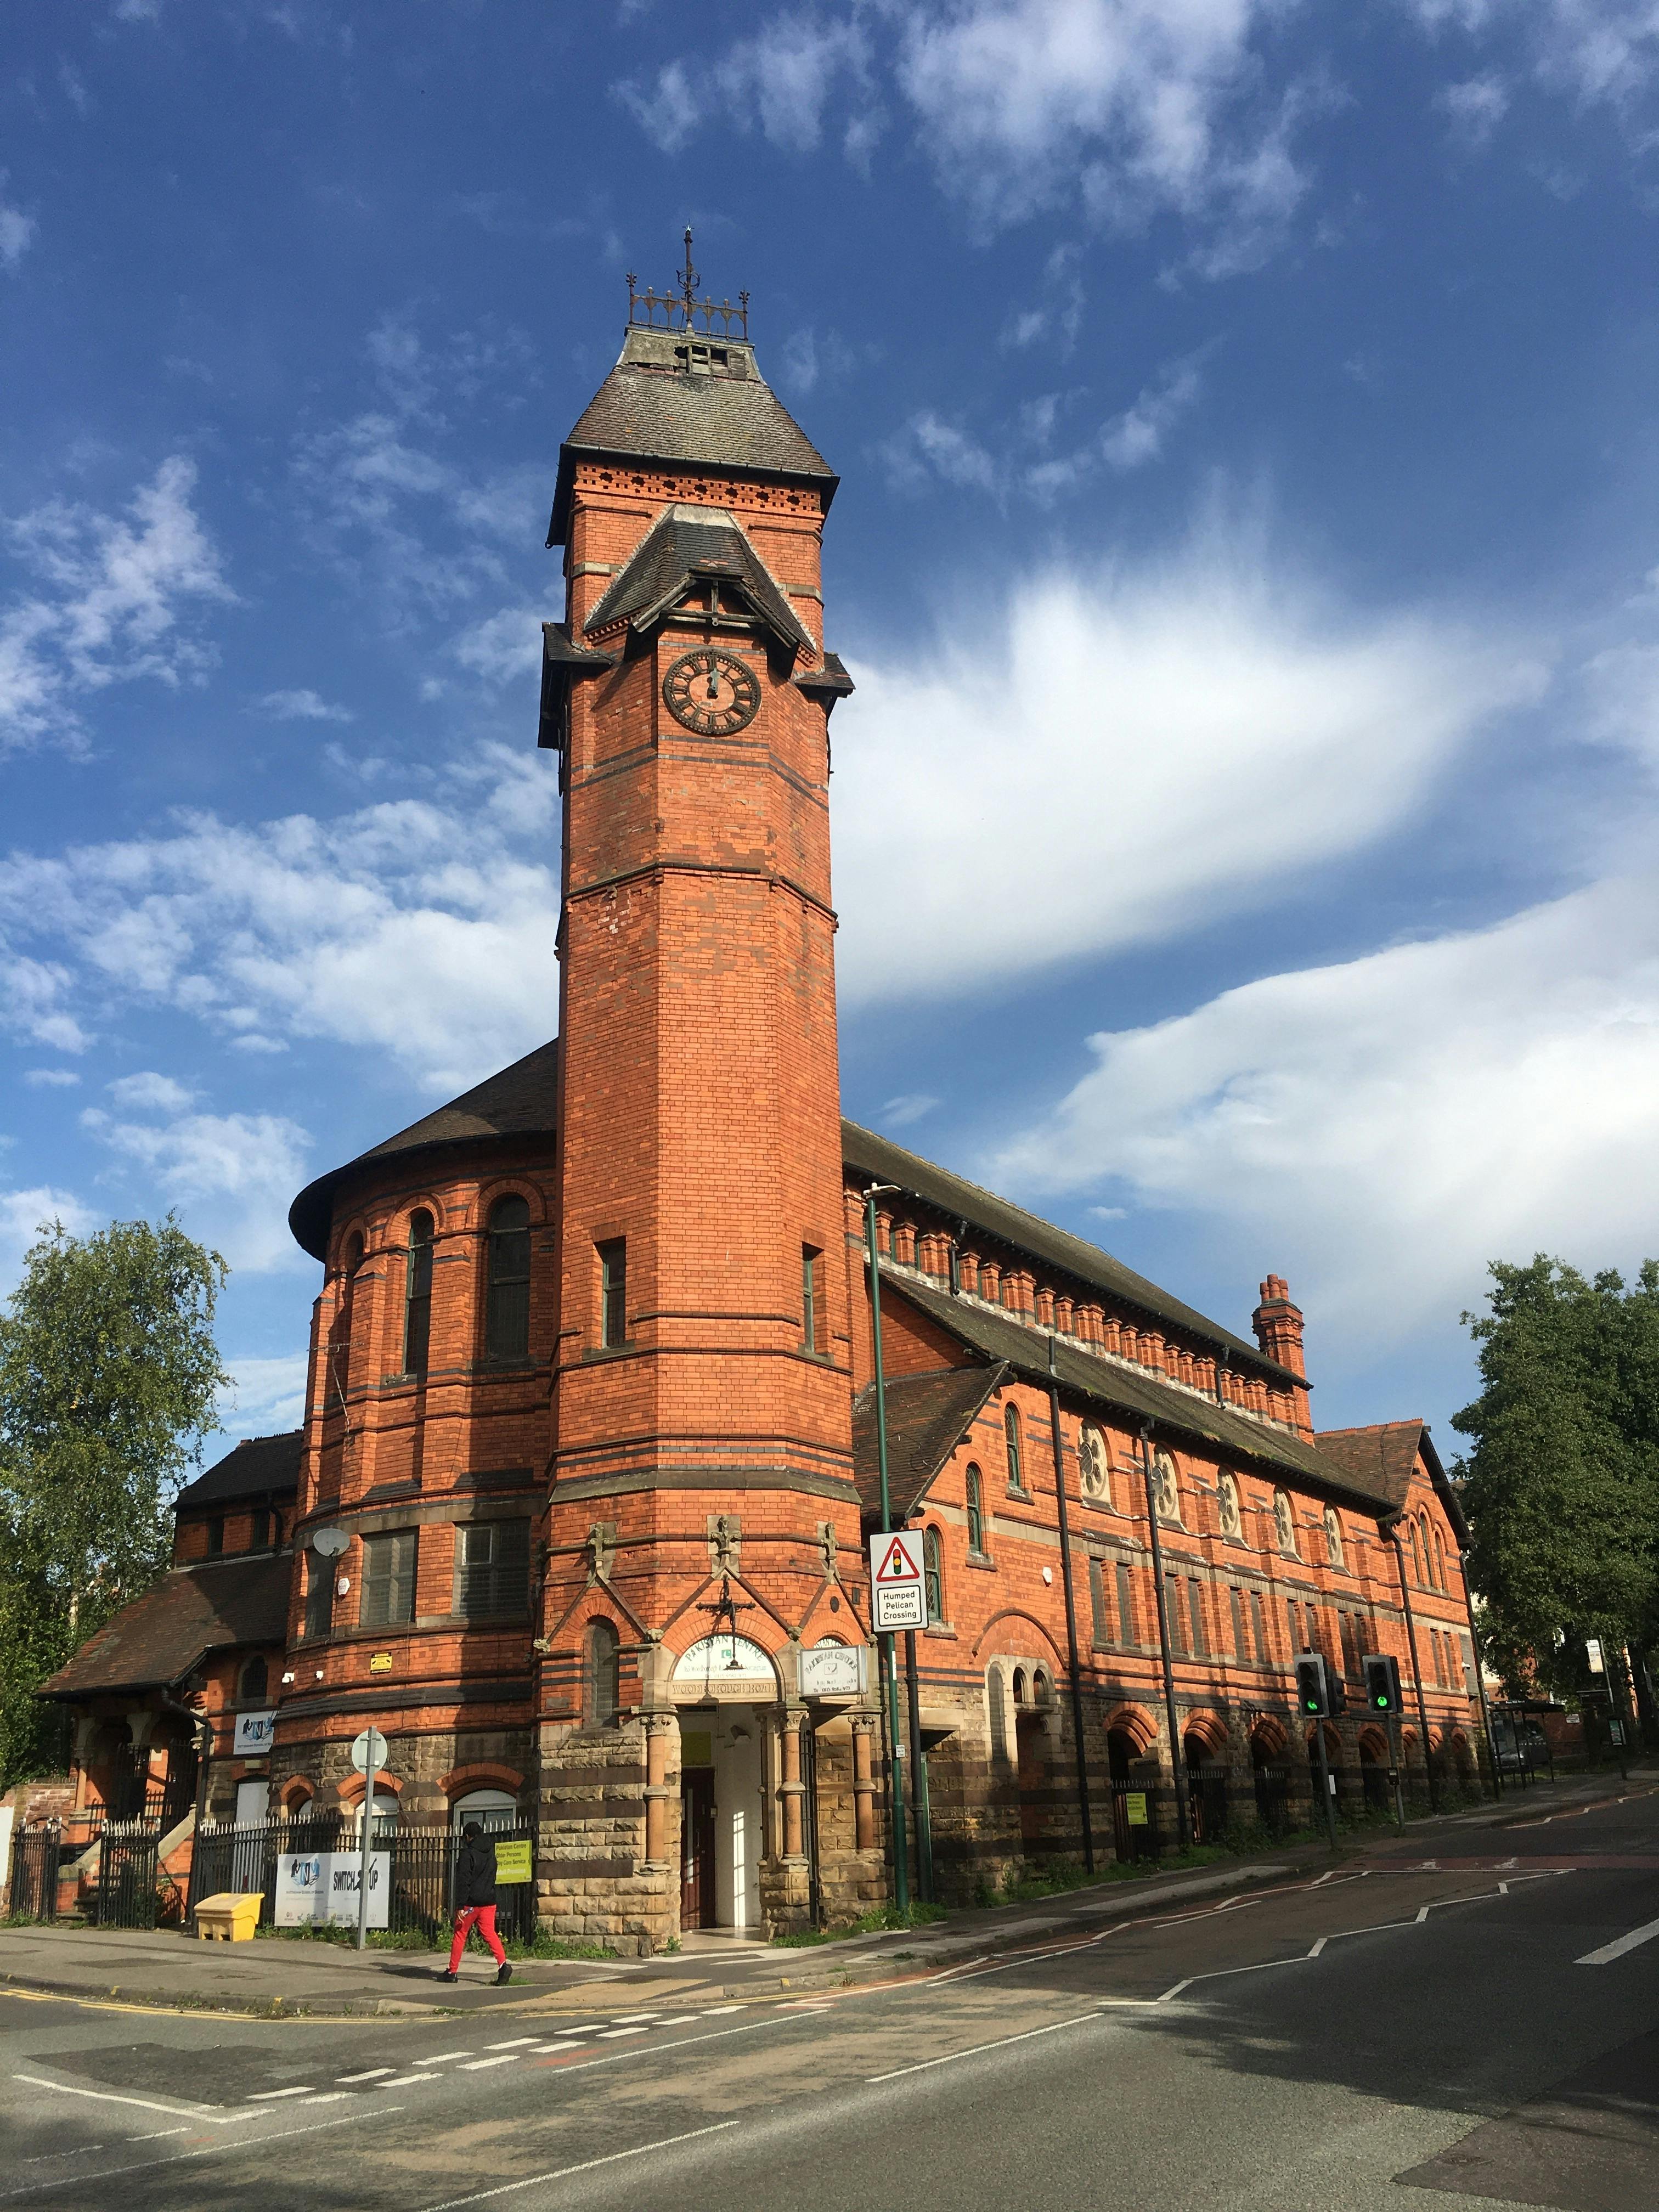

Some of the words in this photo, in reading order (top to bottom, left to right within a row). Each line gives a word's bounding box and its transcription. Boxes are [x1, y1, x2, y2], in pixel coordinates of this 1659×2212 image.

[883, 1590, 915, 1600] Humped
[886, 1601, 913, 1610] Pelican
[883, 1611, 917, 1620] Crossing
[735, 1637, 766, 1662] ENTRE
[672, 1684, 745, 1695] WOODOROUGH
[333, 1870, 356, 1891] SWITCH
[369, 1870, 379, 1891] UP
